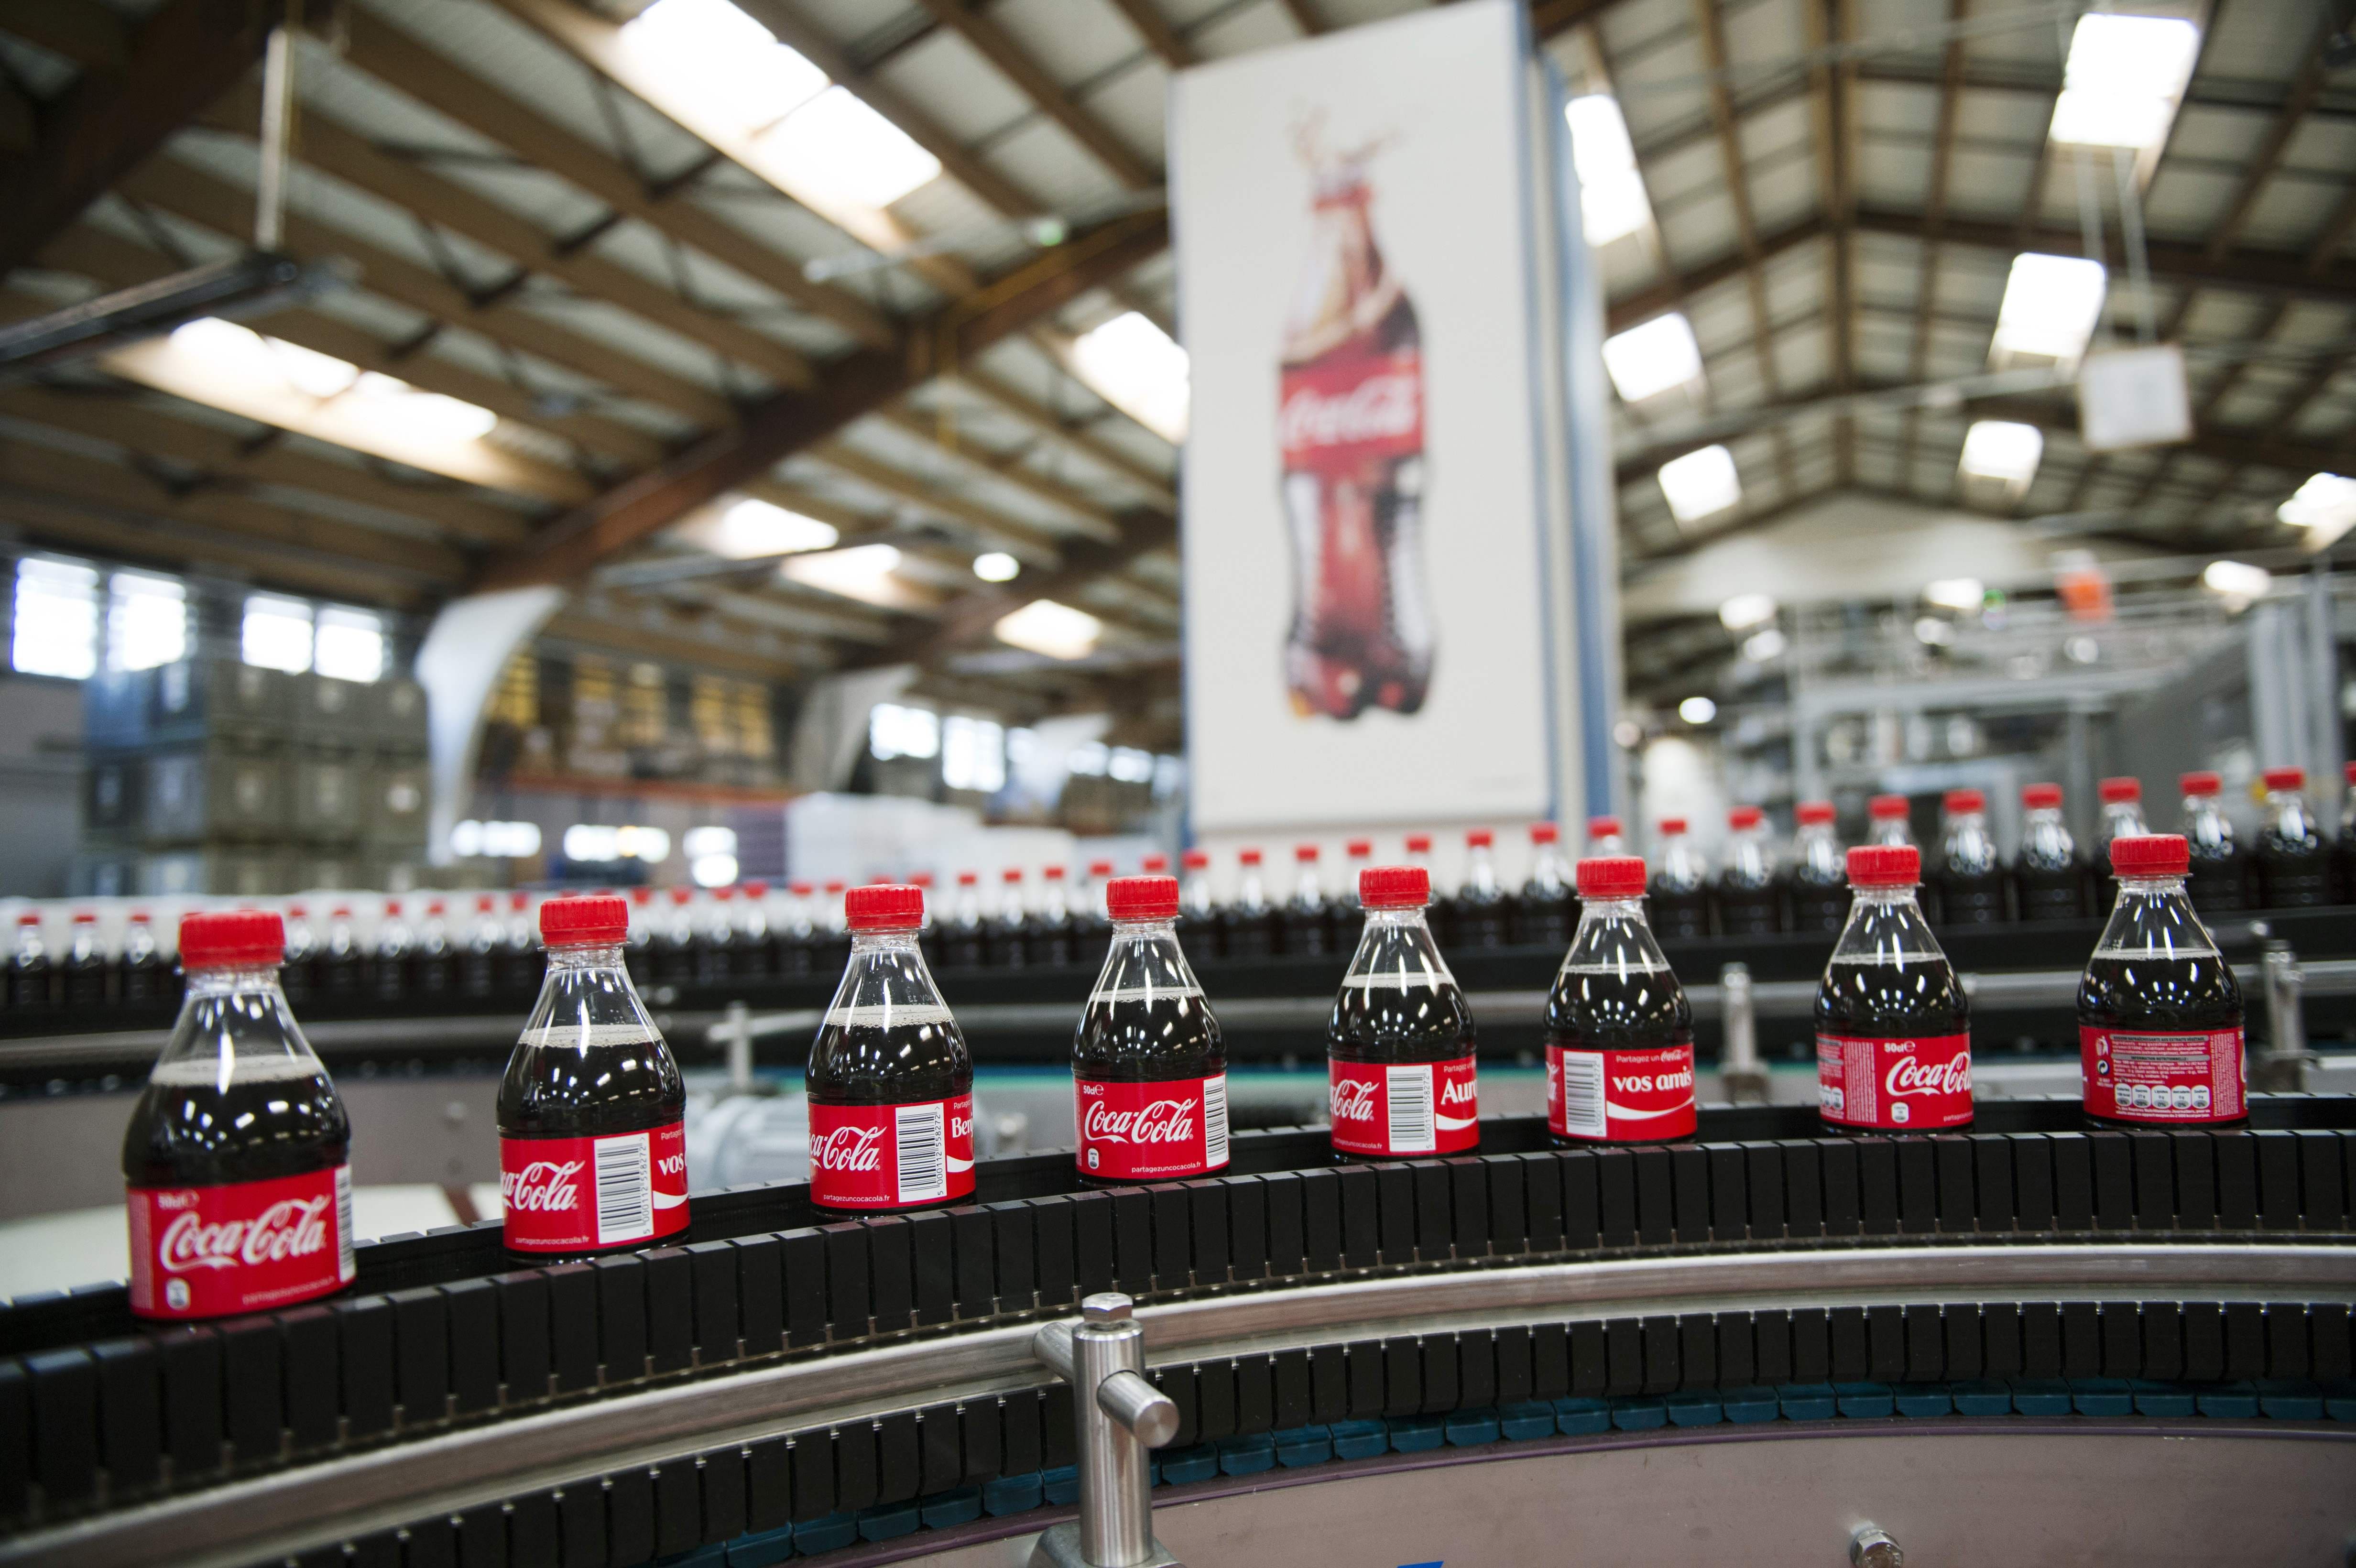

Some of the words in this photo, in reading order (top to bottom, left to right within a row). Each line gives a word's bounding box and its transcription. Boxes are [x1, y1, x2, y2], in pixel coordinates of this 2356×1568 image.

[1612, 1076, 1652, 1092] vos
[1656, 1065, 1692, 1091] amis
[1085, 1098, 1198, 1143] Coca-Cola
[658, 1153, 684, 1176] vos
[1132, 1161, 1201, 1174] partagezuncocacola.fr
[823, 1194, 890, 1202] partagezuncocacola.fr
[160, 1195, 332, 1273] Coca-Cola
